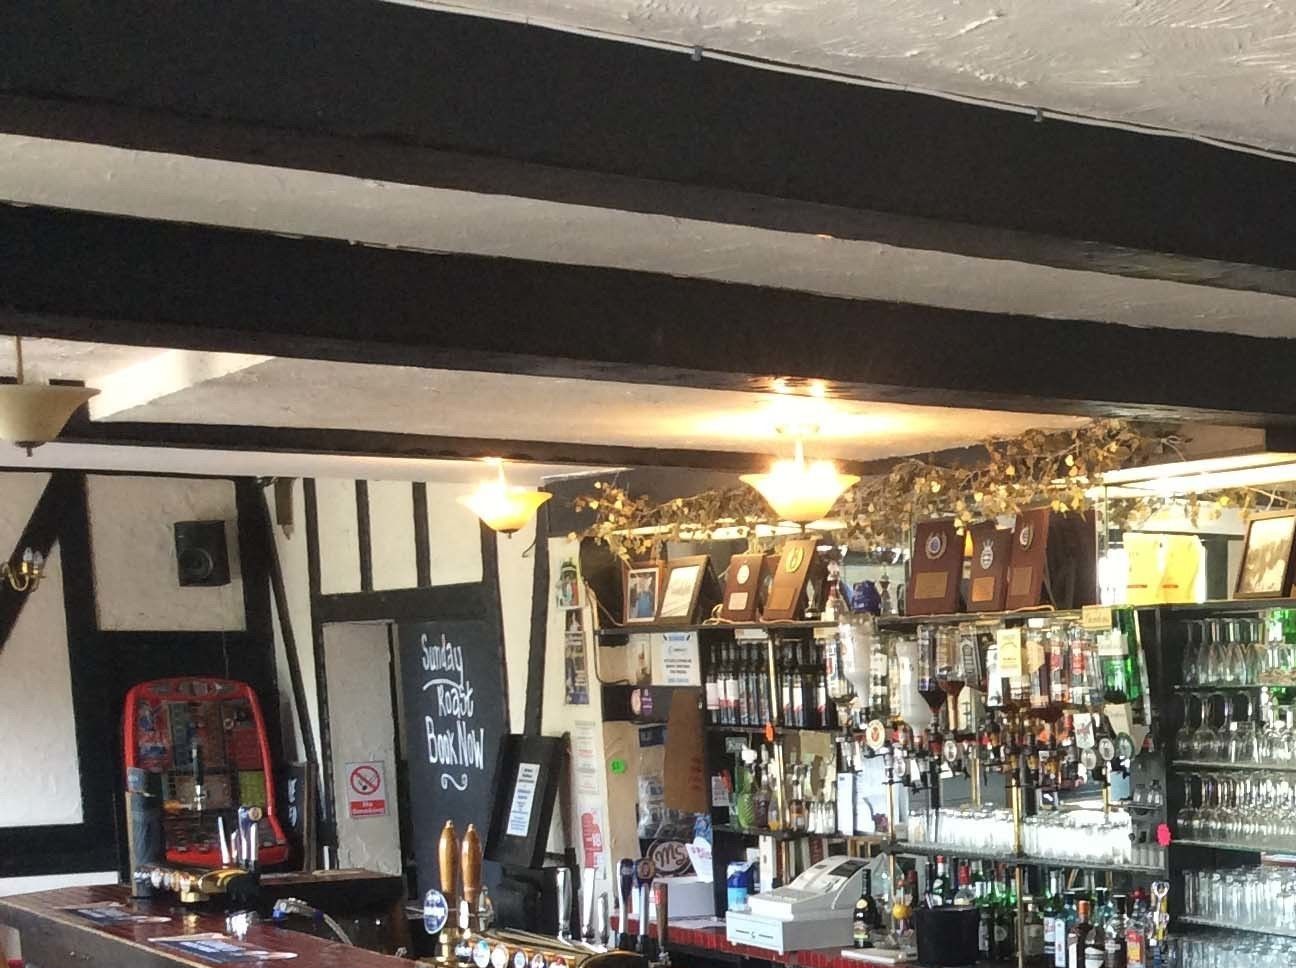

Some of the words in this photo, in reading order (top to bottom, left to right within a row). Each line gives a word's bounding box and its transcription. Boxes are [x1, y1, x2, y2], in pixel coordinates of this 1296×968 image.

[420, 632, 464, 682] Sunday
[436, 680, 474, 718] Roast
[424, 715, 457, 765] Book
[456, 719, 484, 770] Now
